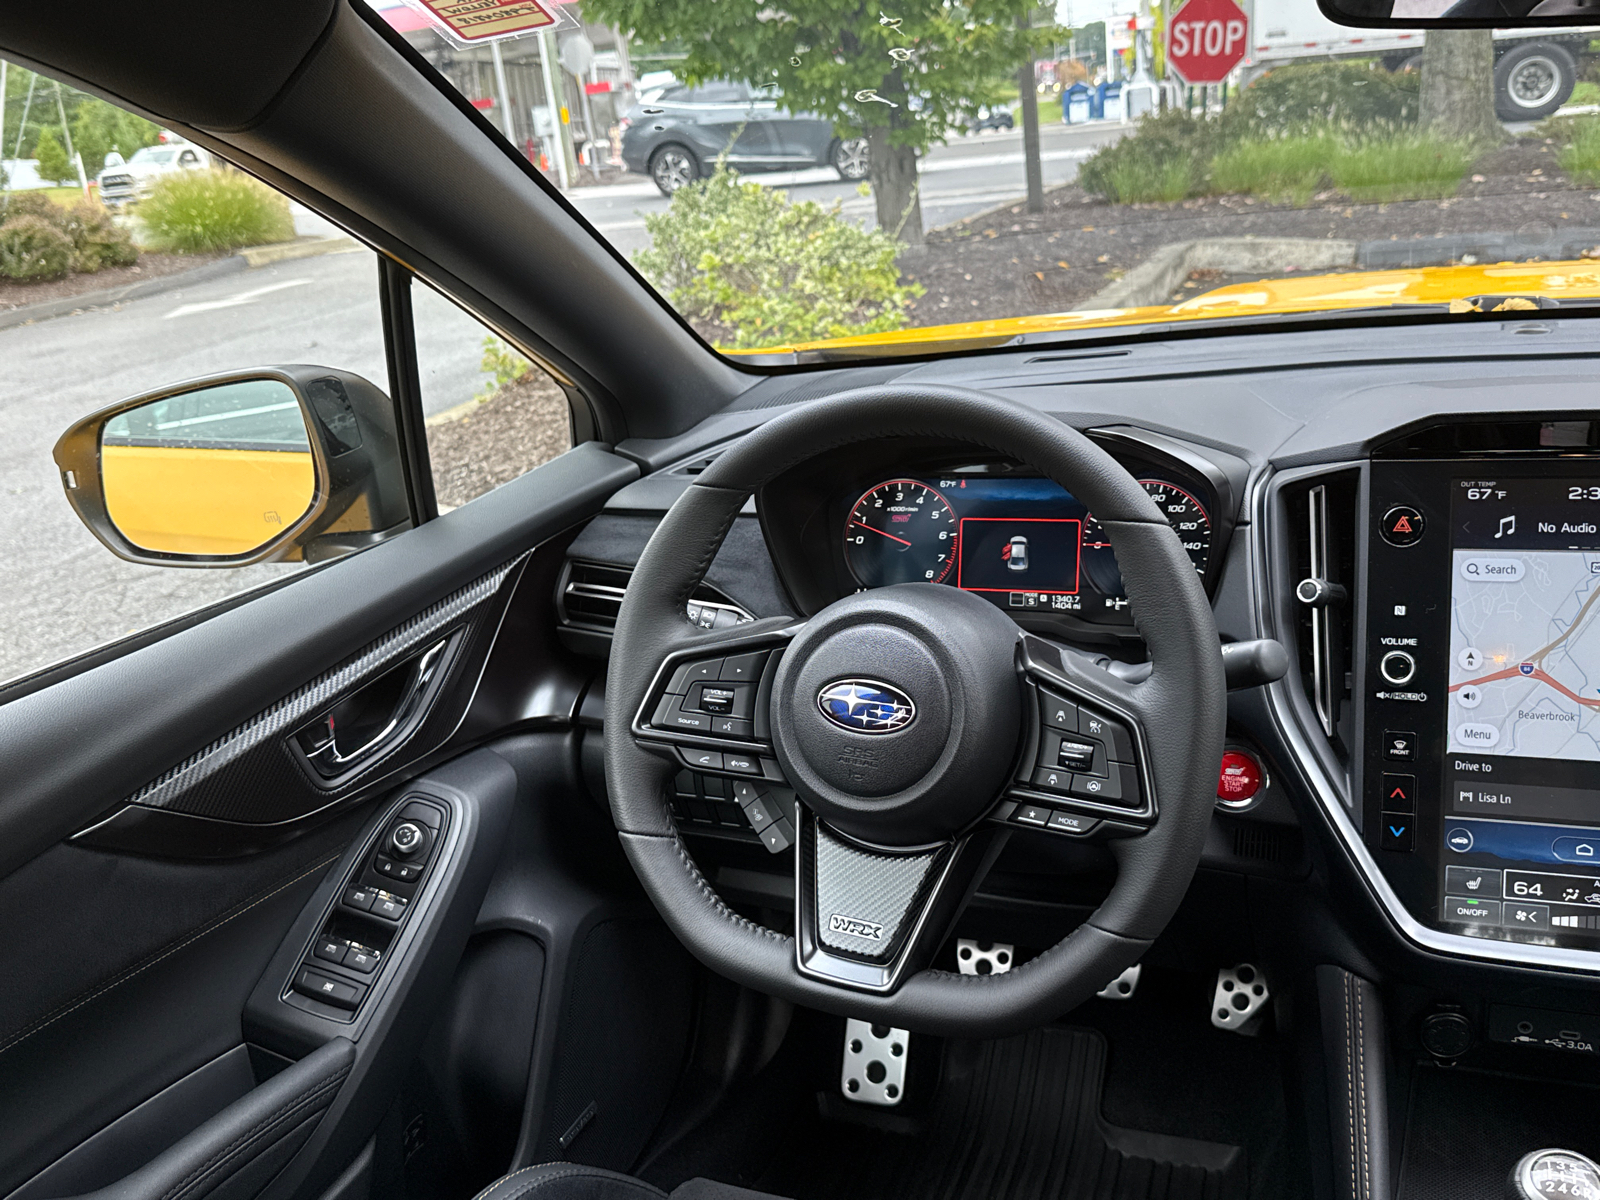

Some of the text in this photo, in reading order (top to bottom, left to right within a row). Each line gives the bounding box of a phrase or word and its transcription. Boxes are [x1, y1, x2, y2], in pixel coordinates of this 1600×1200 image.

[1172, 20, 1245, 57] STOP
[895, 492, 904, 501] 3
[931, 511, 940, 519] 5
[1538, 522, 1597, 533] No Audio
[856, 536, 864, 544] 0
[925, 570, 934, 578] 8
[1485, 564, 1517, 575] Search
[1518, 710, 1575, 722] Beaverbrook
[1464, 730, 1491, 739] Menu
[1455, 761, 1492, 772] Drive to
[1478, 793, 1512, 804] Lisa Ln
[1058, 817, 1079, 826] MODE
[1513, 882, 1543, 896] 64
[1457, 908, 1488, 917] ON/OFF
[832, 916, 882, 939] WRX
[1566, 1041, 1593, 1051] 3.0A
[1545, 1181, 1555, 1192] 2
[1558, 1183, 1568, 1194] 4
[1571, 1185, 1581, 1196] 6
